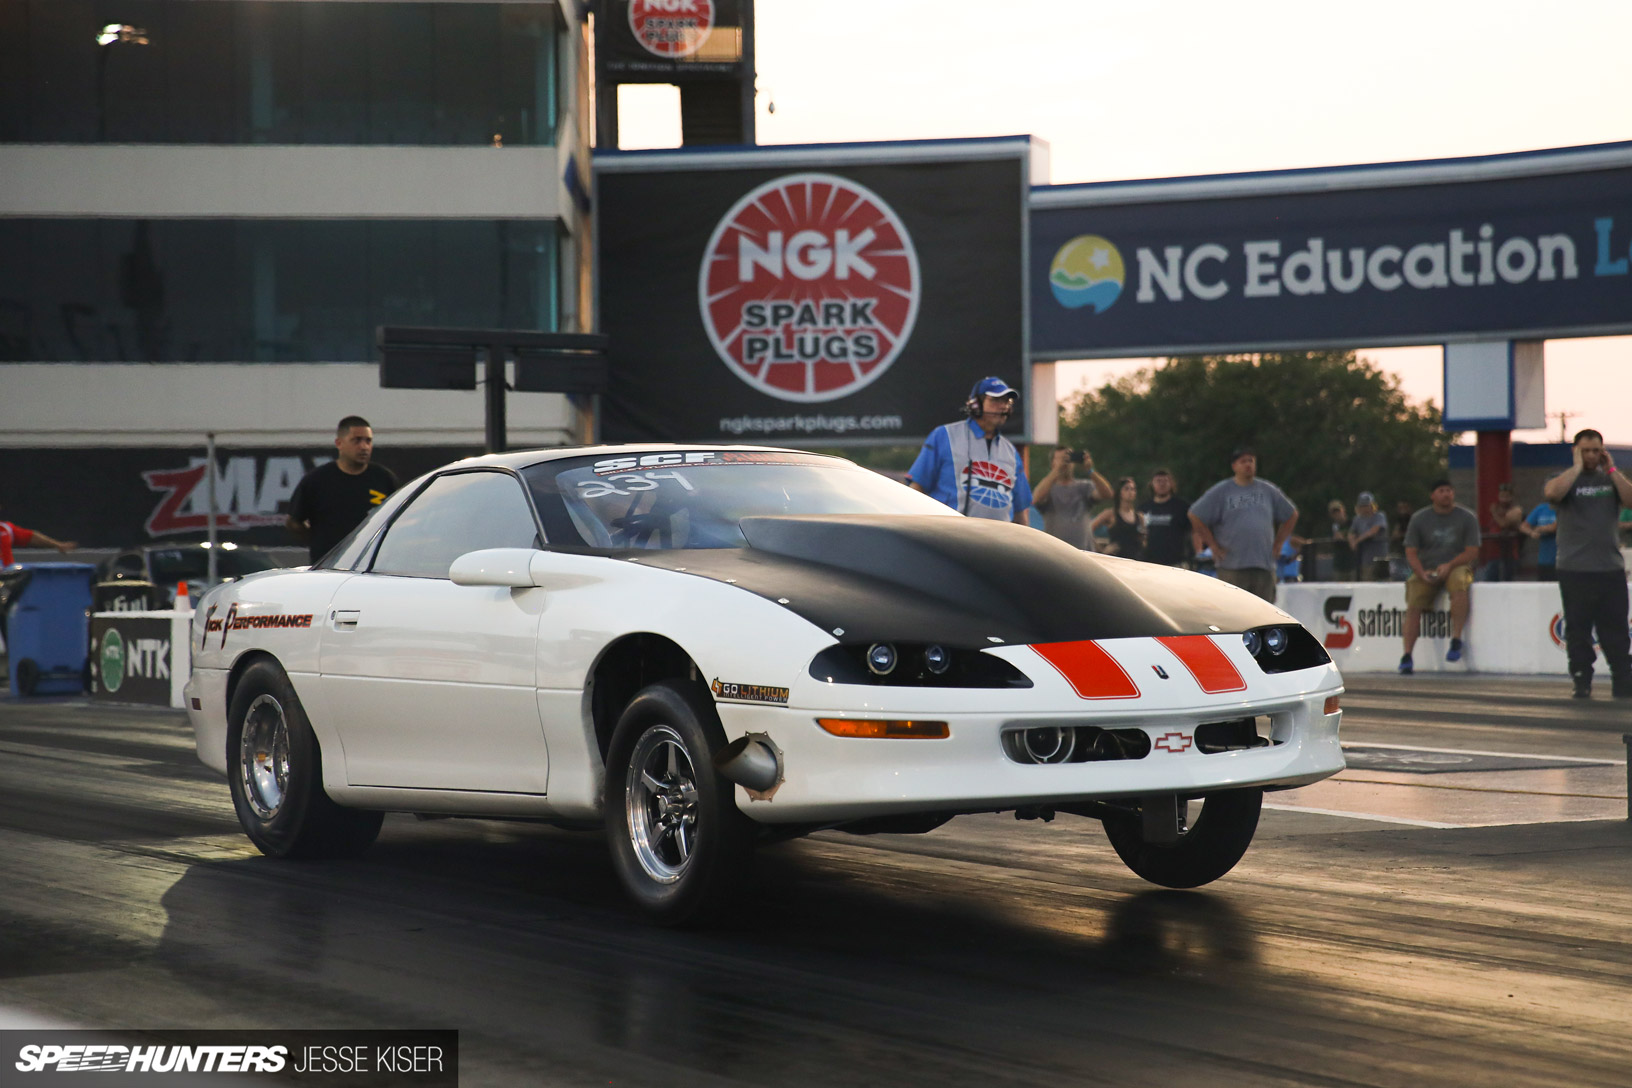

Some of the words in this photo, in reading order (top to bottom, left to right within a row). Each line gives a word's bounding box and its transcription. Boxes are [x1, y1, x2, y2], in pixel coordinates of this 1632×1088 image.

[737, 228, 878, 282] NGK
[1136, 243, 1229, 303] NC
[1244, 224, 1578, 297] Education
[1594, 216, 1632, 276] L
[743, 300, 878, 329] SPARK
[743, 333, 878, 364] PLUGS
[719, 415, 903, 434] ngksparkplugs.com
[221, 602, 314, 650] PERFORMANCE
[127, 638, 170, 679] NTK
[723, 683, 738, 694] GO
[741, 685, 789, 698] LITHIUM
